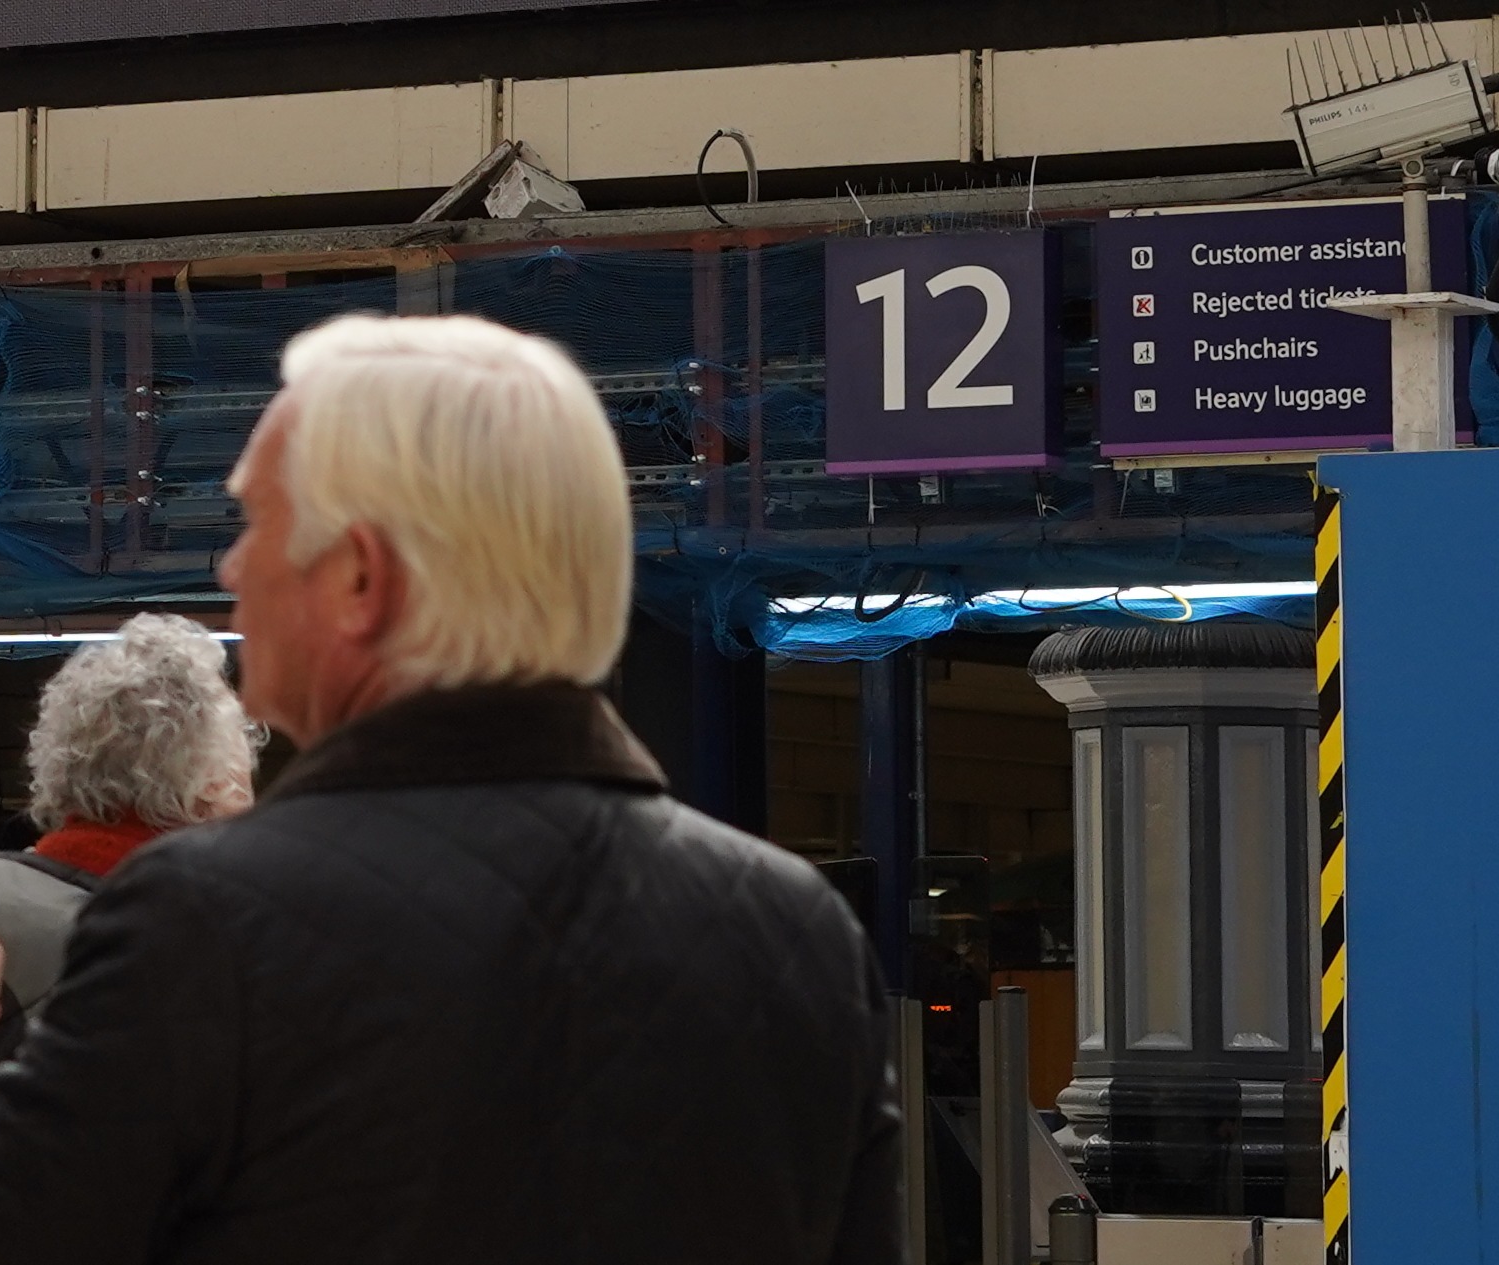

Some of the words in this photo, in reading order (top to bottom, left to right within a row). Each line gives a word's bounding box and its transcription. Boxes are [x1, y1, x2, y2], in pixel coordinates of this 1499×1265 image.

[1191, 243, 1304, 266] Customer
[1193, 288, 1292, 318] Rejected
[855, 265, 1014, 411] 12
[1194, 337, 1318, 361] Pushchairs
[1195, 388, 1267, 413] Heavy
[1275, 385, 1367, 411] luggage
